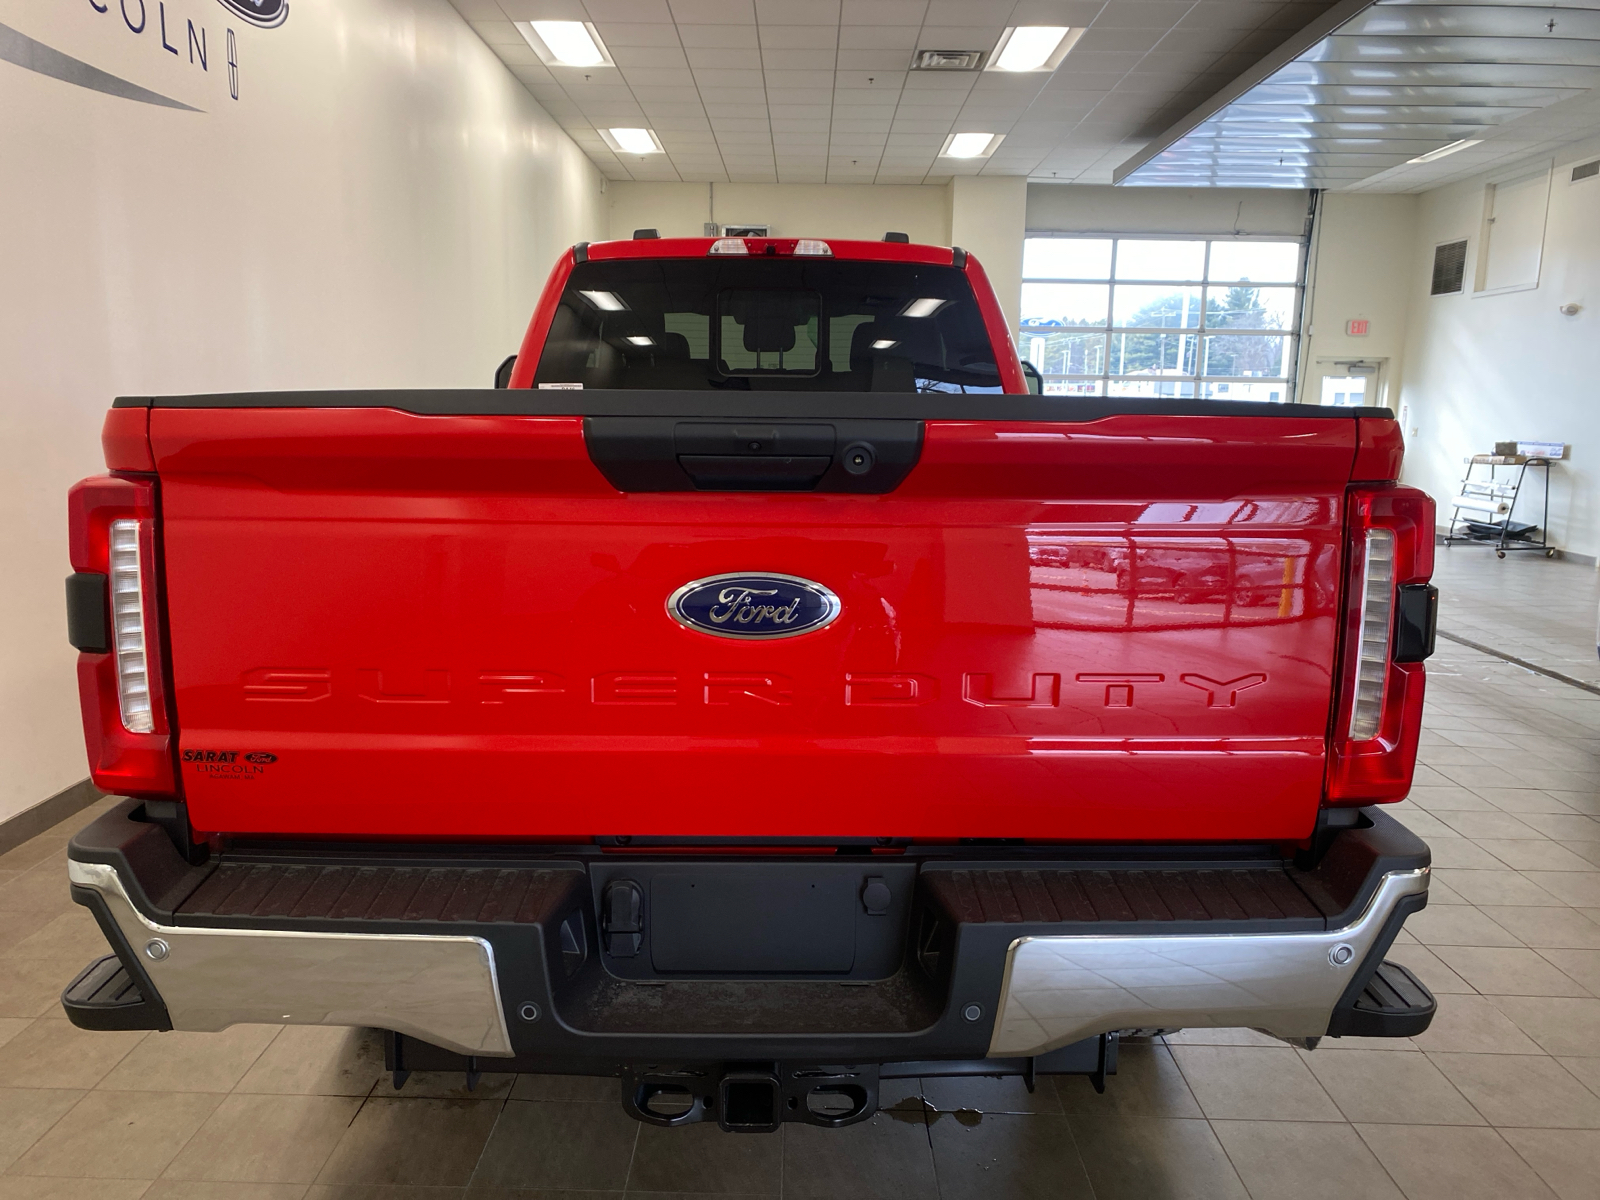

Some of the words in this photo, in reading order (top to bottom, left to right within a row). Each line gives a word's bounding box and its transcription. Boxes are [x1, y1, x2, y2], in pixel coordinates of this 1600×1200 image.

[89, 0, 208, 72] OLN
[1351, 320, 1368, 334] EXIT
[709, 586, 801, 624] Ford
[241, 666, 793, 706] SUPER
[845, 671, 1269, 708] DUTY
[183, 749, 239, 763] SARAT
[196, 764, 264, 774] LINCOLN
